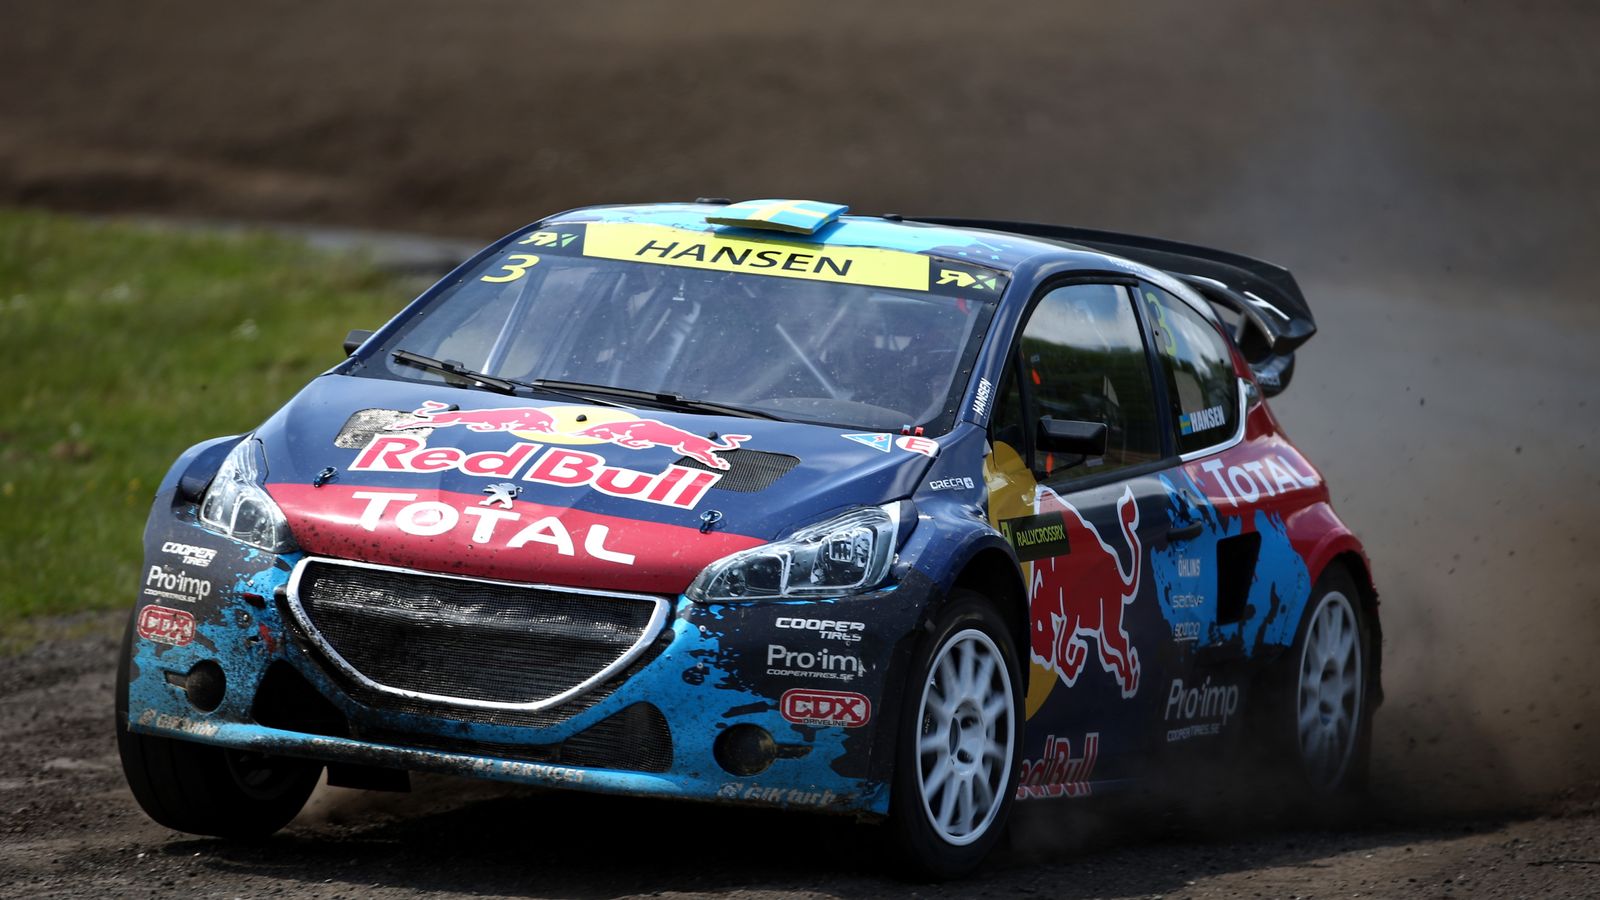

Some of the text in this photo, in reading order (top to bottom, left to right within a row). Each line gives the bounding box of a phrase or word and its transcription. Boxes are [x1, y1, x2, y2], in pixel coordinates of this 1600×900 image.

[480, 254, 540, 283] 3
[635, 240, 852, 277] HANSEN
[1145, 292, 1177, 356] 3
[972, 377, 992, 416] HANSEN
[1189, 405, 1226, 433] HANSEN
[347, 433, 724, 510] Red Bull
[1201, 456, 1320, 508] TOTAL
[351, 491, 636, 565] TOTAL
[1016, 525, 1066, 547] RALLYCROSSRX
[161, 541, 218, 560] COOPER
[182, 555, 212, 567] TIRES
[775, 617, 866, 632] COOPER
[819, 630, 862, 642] TIRES
[789, 694, 863, 722] CDX
[802, 718, 848, 727] DRIVELINE
